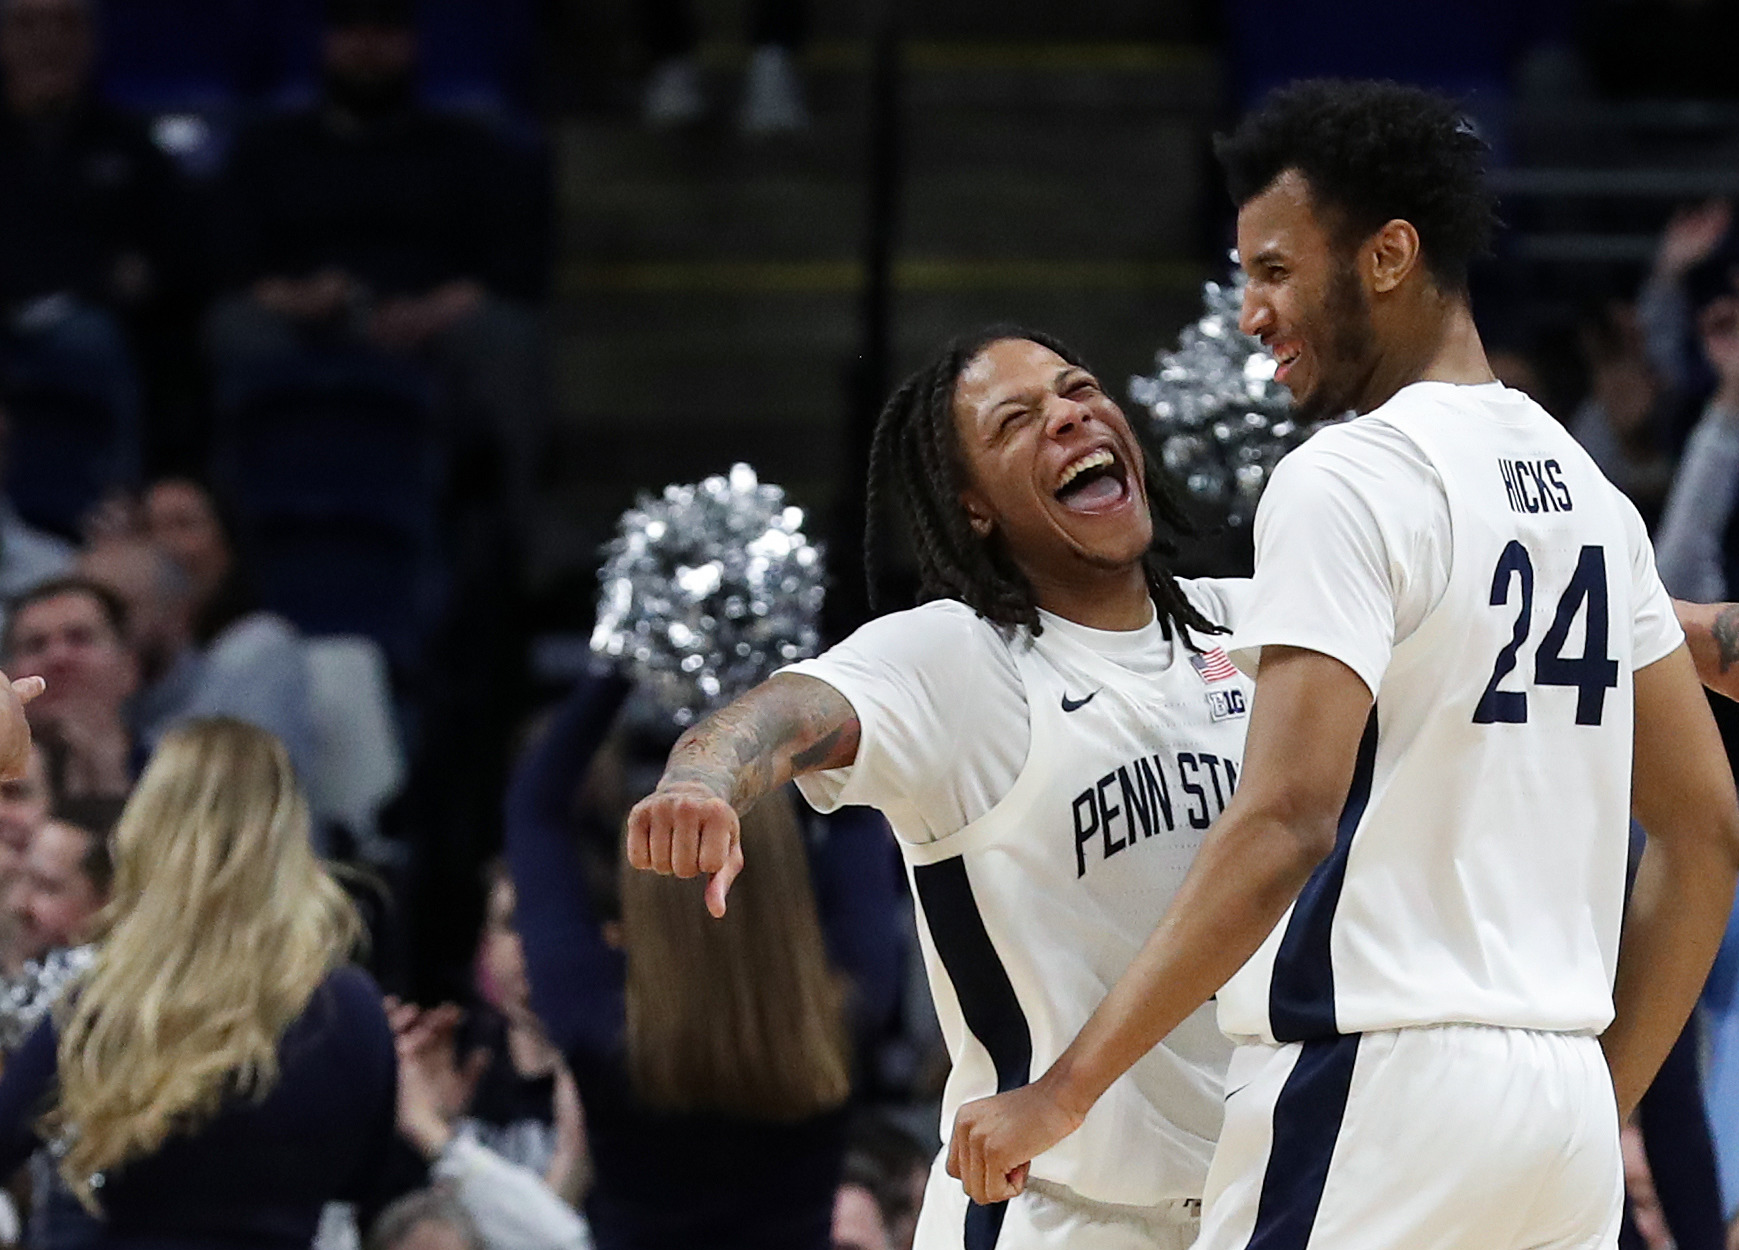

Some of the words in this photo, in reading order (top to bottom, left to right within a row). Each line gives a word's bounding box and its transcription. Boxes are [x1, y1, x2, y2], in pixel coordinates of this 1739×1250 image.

[1498, 458, 1573, 513] HICKS
[1472, 540, 1618, 726] 24
[1072, 754, 1174, 879] PENN
